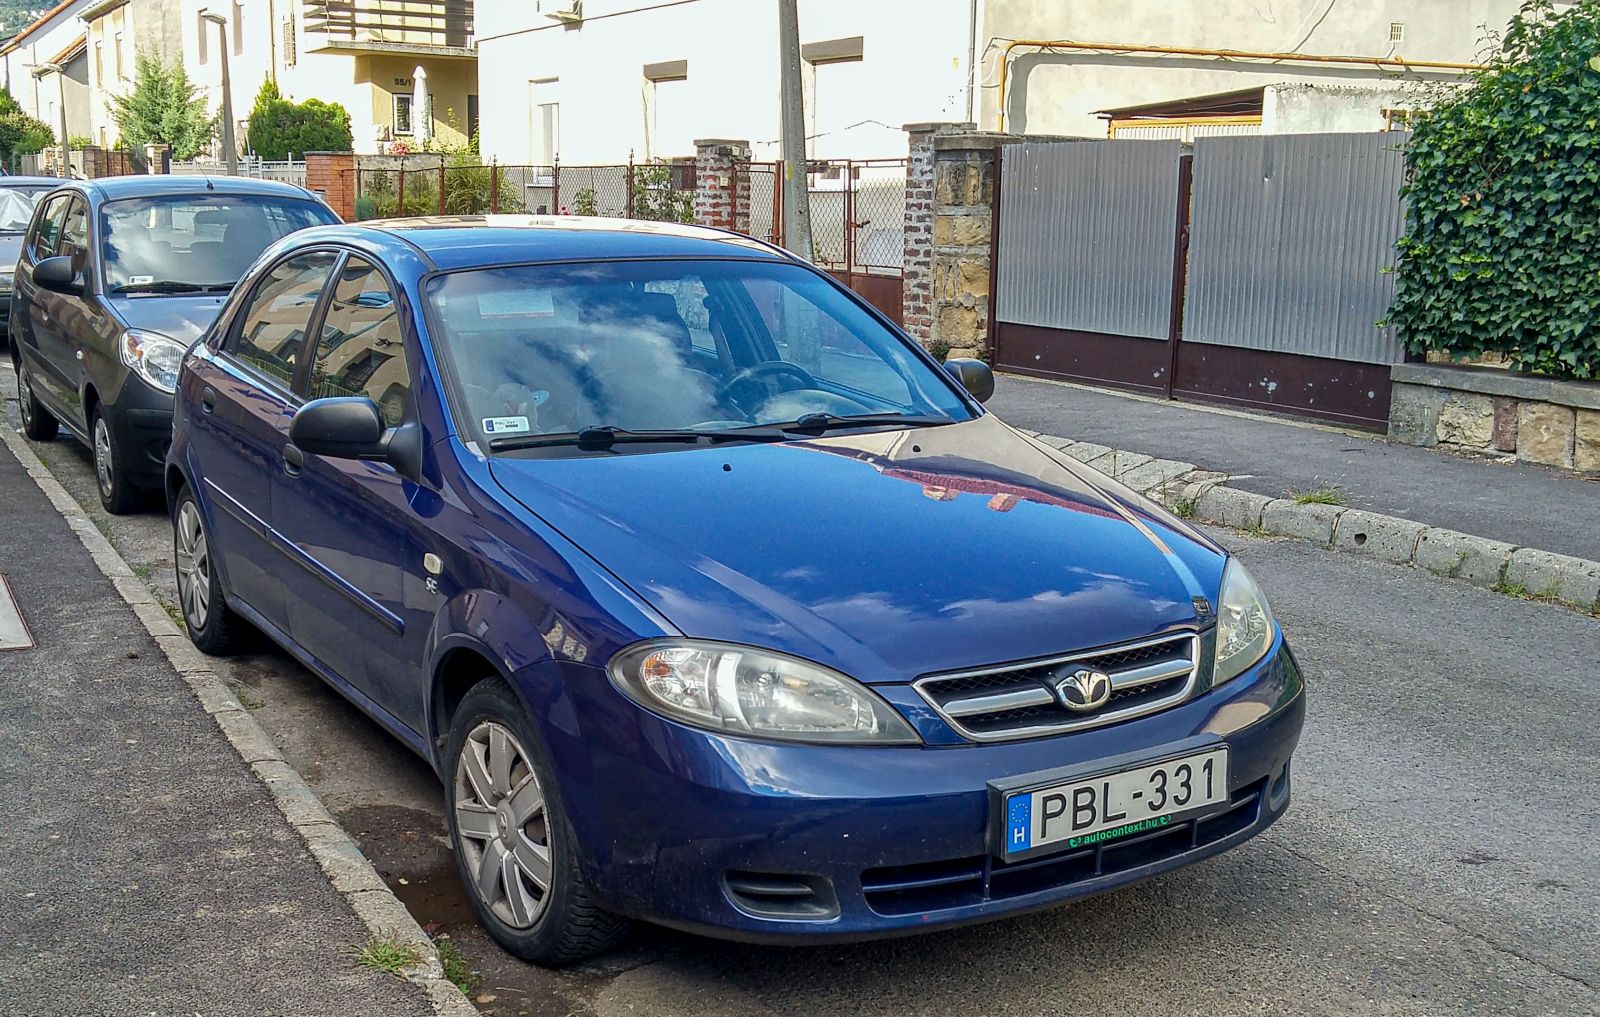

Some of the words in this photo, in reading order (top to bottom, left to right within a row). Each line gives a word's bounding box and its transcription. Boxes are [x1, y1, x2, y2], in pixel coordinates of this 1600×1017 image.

[394, 78, 411, 86] 55/1
[1013, 826, 1025, 844] H
[1040, 757, 1214, 839] PBL-331
[1083, 817, 1159, 845] autocontext.hu
